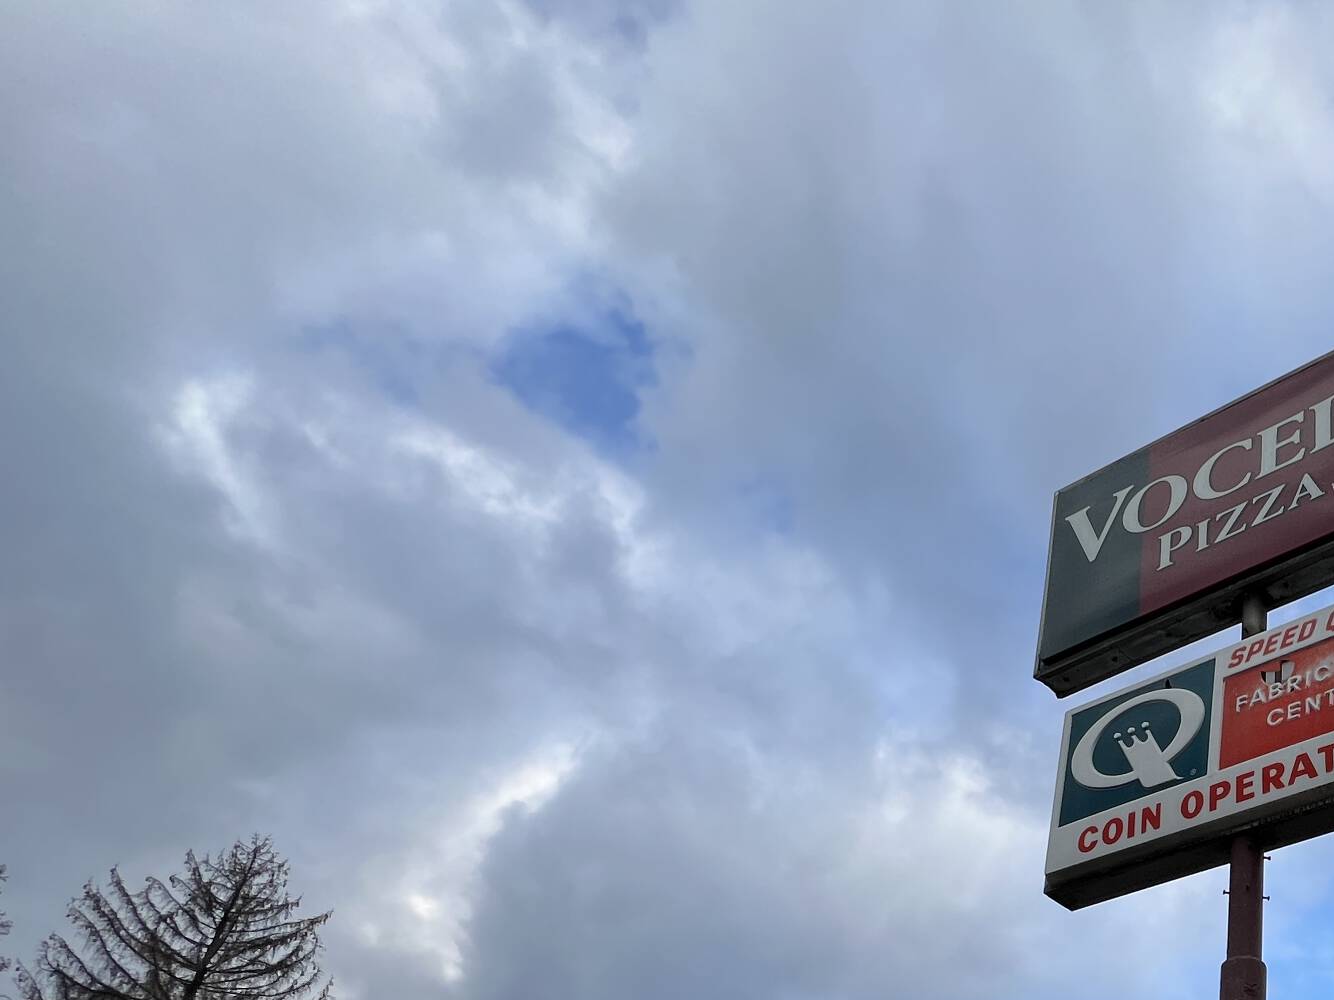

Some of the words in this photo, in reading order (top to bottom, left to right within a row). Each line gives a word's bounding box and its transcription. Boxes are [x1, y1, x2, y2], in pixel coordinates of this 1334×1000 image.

[1153, 472, 1326, 573] PIZZA
[1227, 618, 1317, 669] SPEED
[1234, 663, 1331, 713] FABRIC
[1076, 802, 1163, 854] COIN
